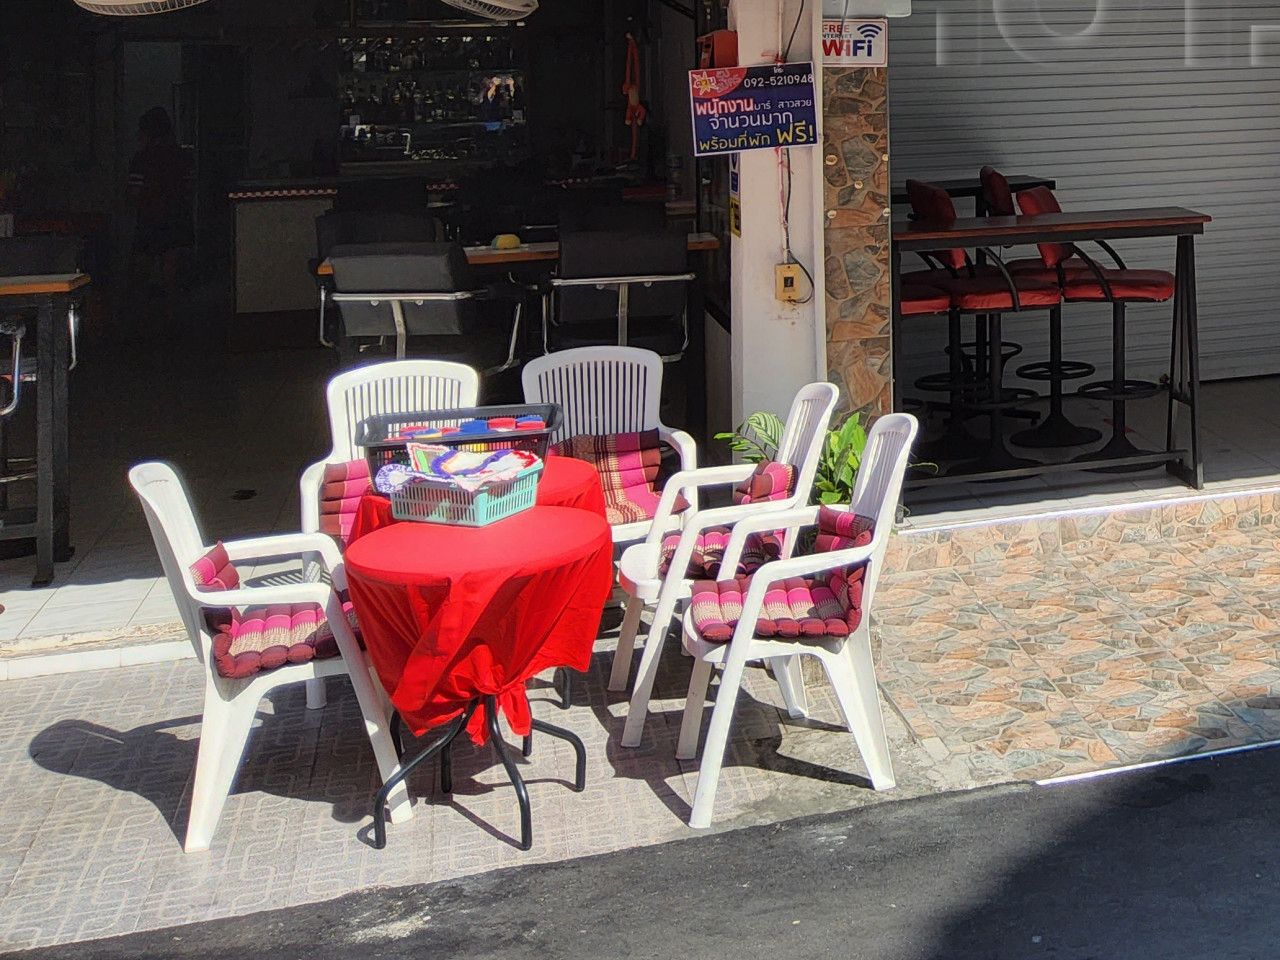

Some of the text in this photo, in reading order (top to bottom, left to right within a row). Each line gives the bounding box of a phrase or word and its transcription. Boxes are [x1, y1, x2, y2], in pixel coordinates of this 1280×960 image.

[822, 24, 851, 33] FREE
[822, 39, 873, 57] WiFi
[743, 74, 814, 89] 092-5210948
[708, 108, 793, 130] จำนวนมาก
[777, 120, 814, 144] ฟรี!
